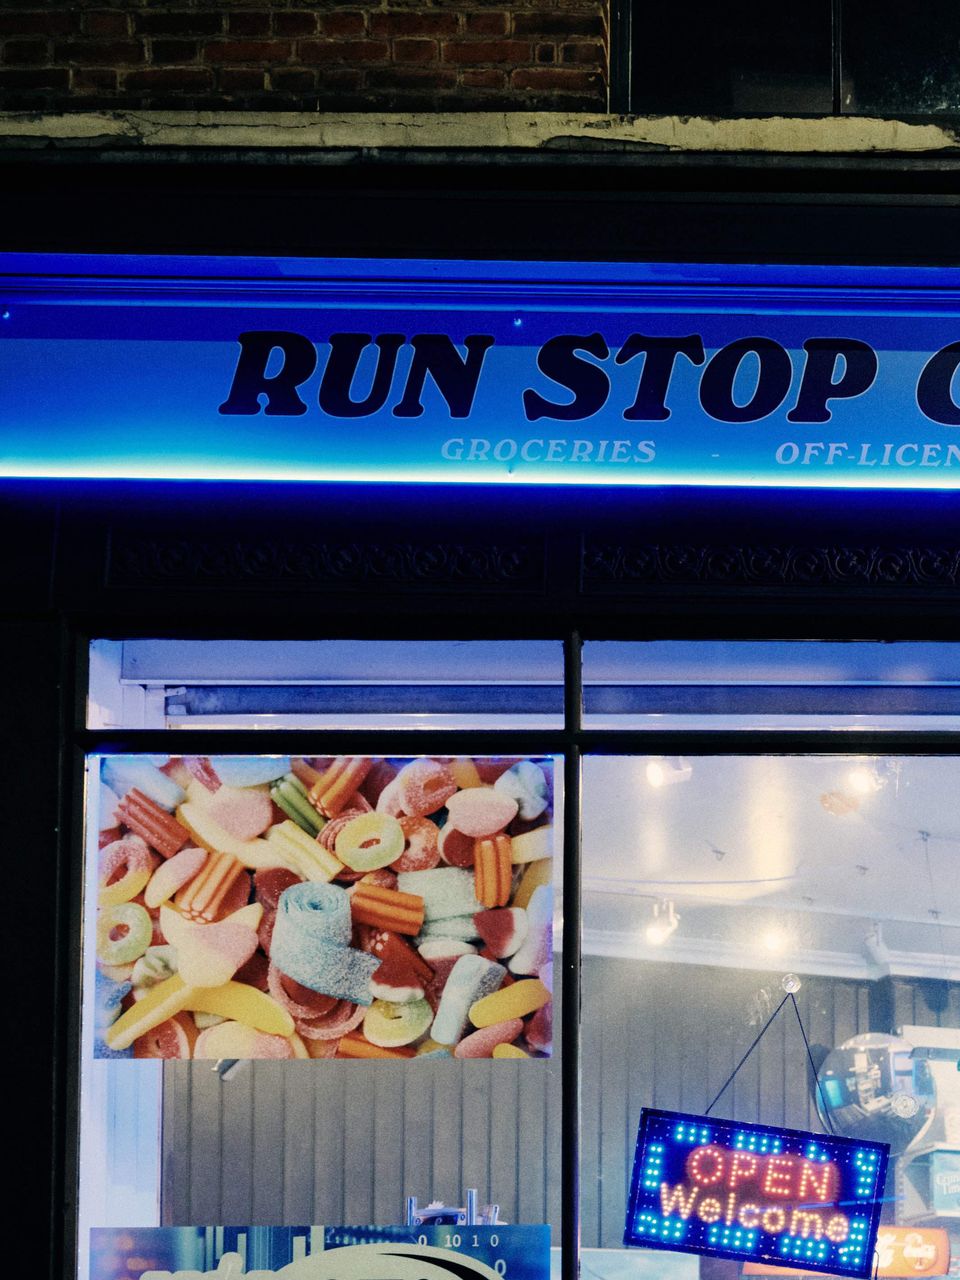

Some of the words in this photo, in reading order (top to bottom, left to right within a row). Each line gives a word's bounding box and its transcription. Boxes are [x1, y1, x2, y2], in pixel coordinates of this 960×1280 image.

[218, 330, 496, 419] RUN
[521, 331, 879, 423] STOP
[440, 436, 657, 464] GROCERIES
[692, 1148, 831, 1202] OPEN
[659, 1181, 850, 1243] Welcome
[444, 1234, 462, 1247] 10
